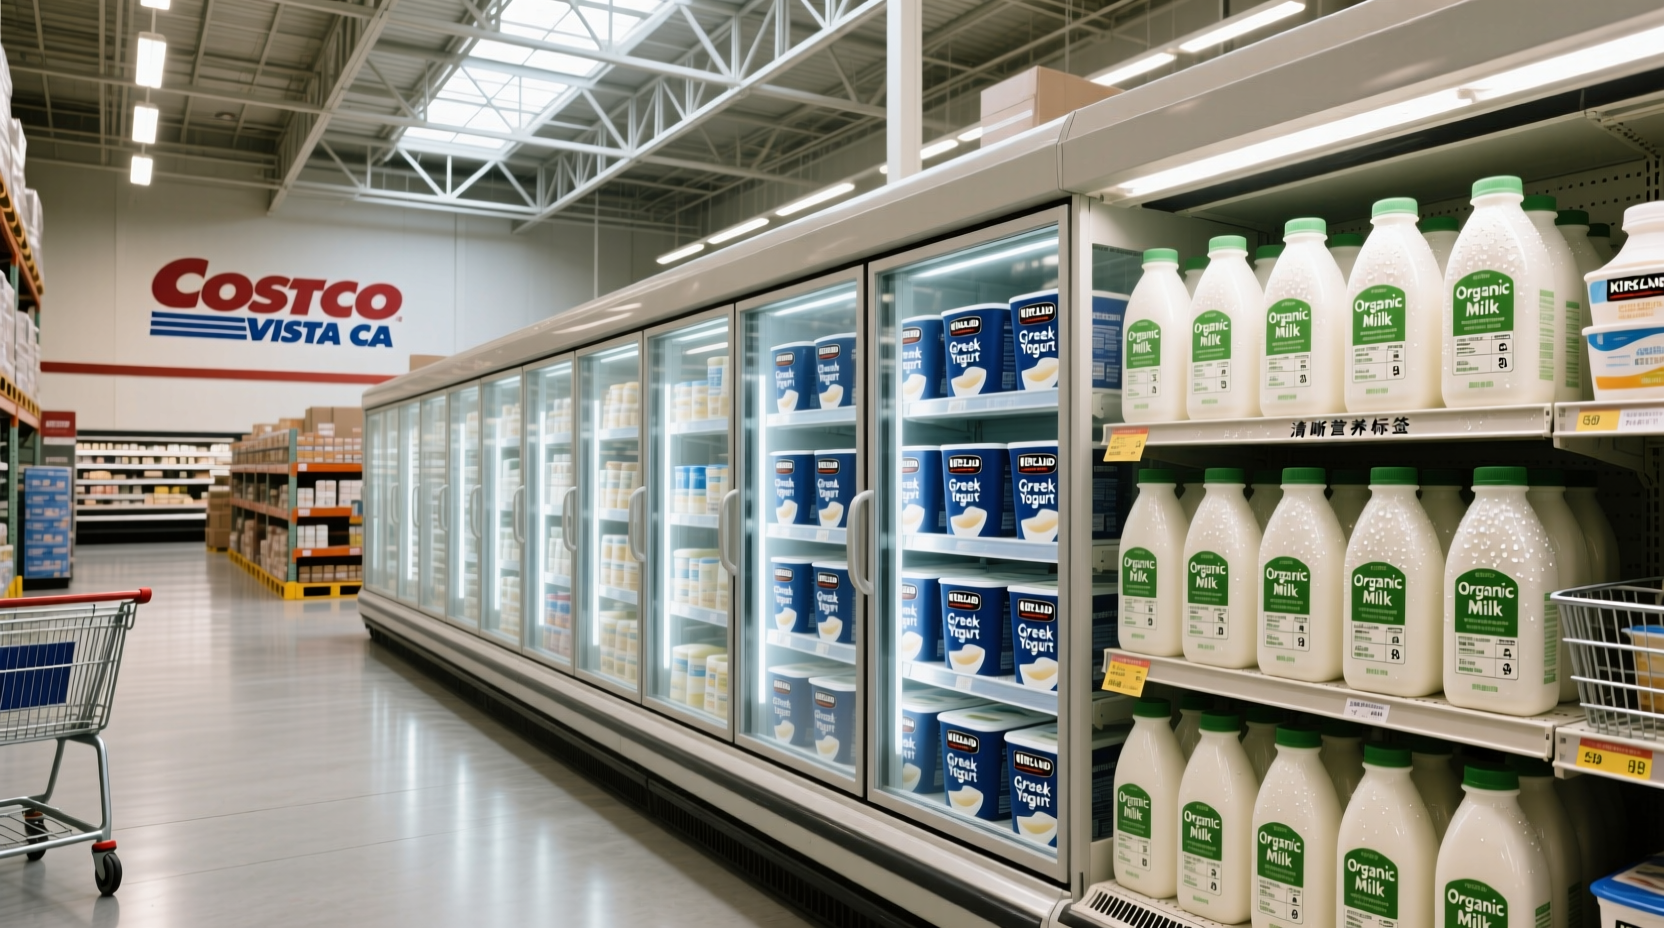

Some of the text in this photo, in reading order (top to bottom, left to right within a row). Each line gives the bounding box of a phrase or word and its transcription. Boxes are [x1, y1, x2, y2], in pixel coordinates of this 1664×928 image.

[152, 258, 402, 320] COSTCO
[1456, 279, 1510, 302] Organic
[1354, 293, 1402, 313] Organic
[1466, 299, 1500, 317] Milk
[1194, 318, 1229, 334] Organic
[1268, 307, 1309, 327] Organic
[1363, 311, 1392, 328] Milk
[247, 318, 393, 348] VISTA CA
[1019, 325, 1055, 343] Greek
[1128, 328, 1159, 343] Organic
[1275, 323, 1300, 339] Milk
[1020, 341, 1056, 358] Yogurt
[1200, 334, 1221, 347] Milk
[948, 477, 981, 492] Greek
[1019, 478, 1056, 494] Greek
[1020, 492, 1055, 509] Yogurt
[1124, 556, 1155, 572] Organic
[1190, 562, 1226, 578] Organic
[1196, 575, 1218, 590] Milk
[1266, 567, 1308, 583] Organic
[1354, 574, 1403, 591] Organic
[1273, 582, 1298, 598] Milk
[1363, 589, 1392, 607] Milk
[1458, 581, 1514, 600] Organic
[1468, 599, 1503, 617] Milk
[1018, 623, 1054, 640] Greek
[1019, 637, 1054, 656] Yogurt
[1014, 775, 1051, 797] Greek
[1184, 810, 1220, 830] Organic
[1190, 824, 1212, 843] Milk
[1259, 831, 1301, 853] Organic
[1266, 848, 1292, 868] Milk
[1347, 858, 1395, 882] Organic
[1355, 875, 1385, 898] Milk
[1447, 888, 1505, 917] Organic
[1457, 909, 1492, 928] Milk
